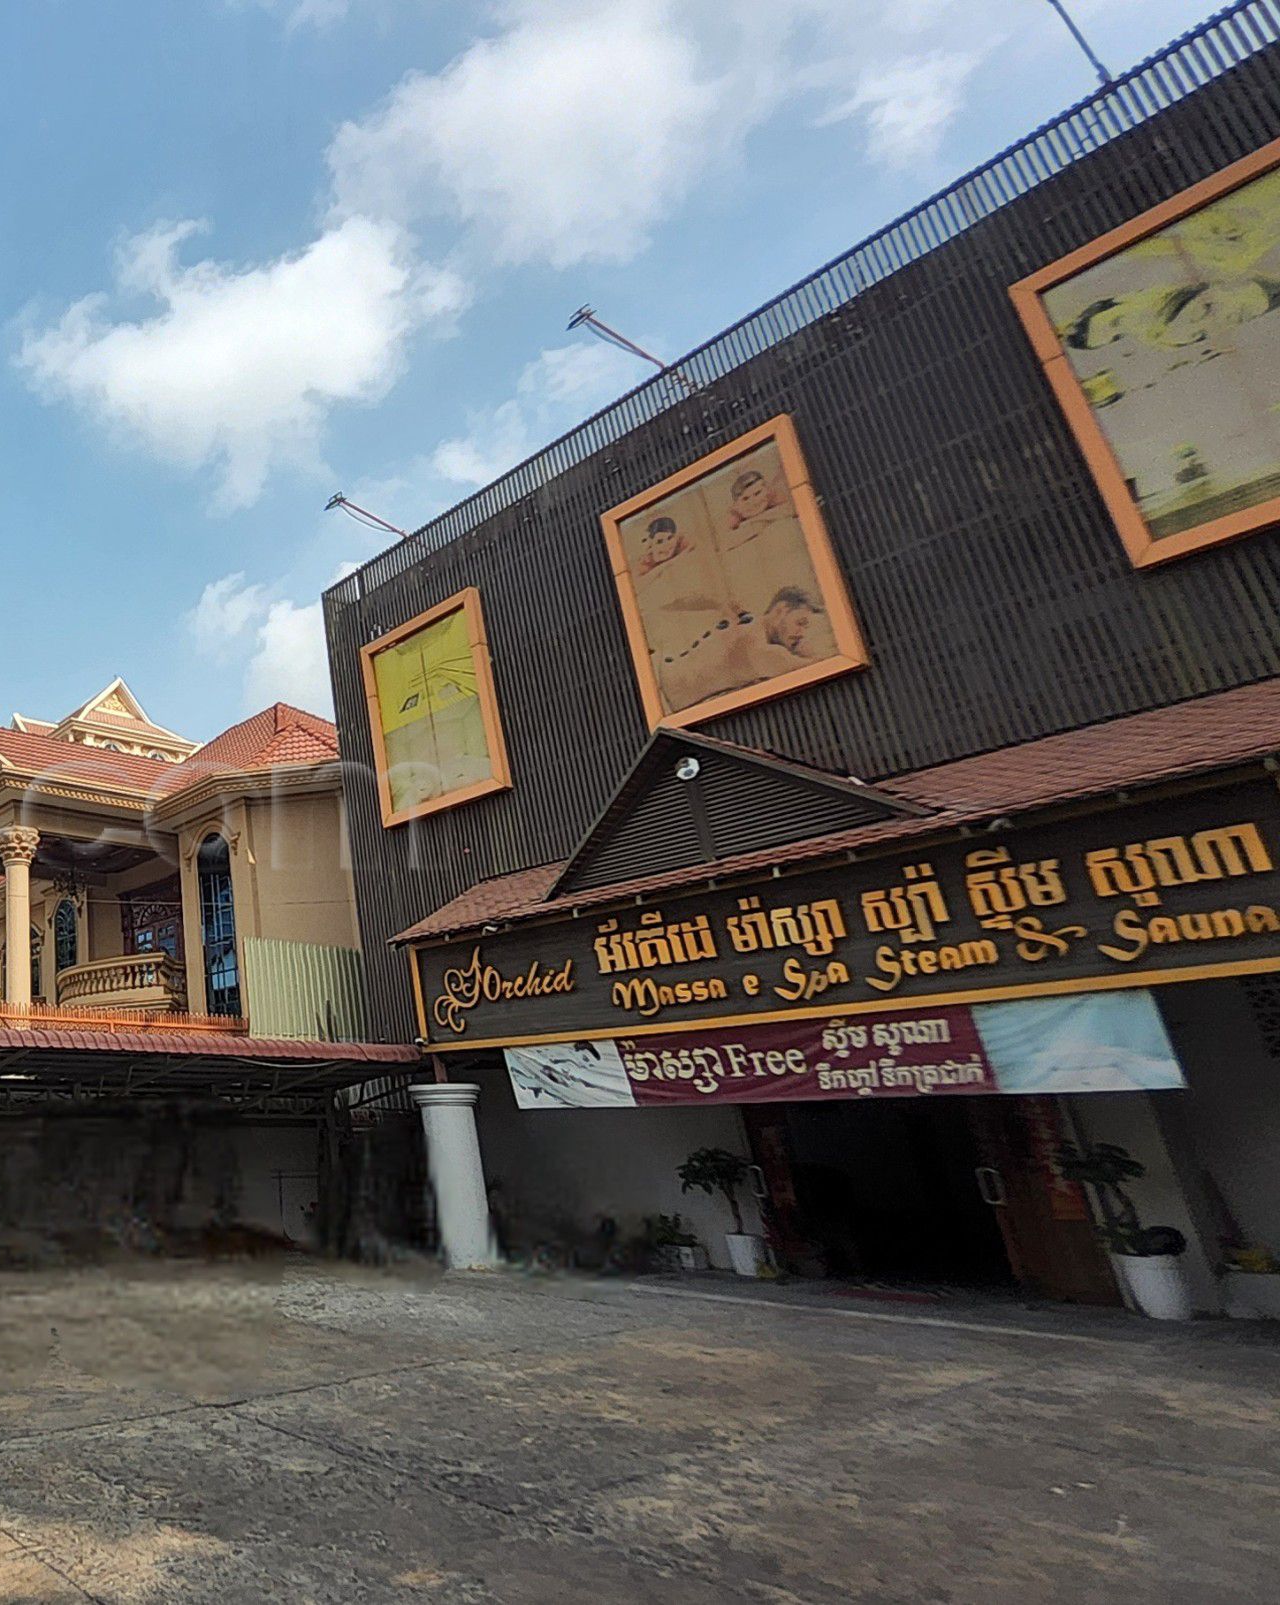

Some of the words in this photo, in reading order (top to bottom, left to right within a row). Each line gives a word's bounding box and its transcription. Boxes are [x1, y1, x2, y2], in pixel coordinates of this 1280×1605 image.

[483, 958, 576, 1001] Orchid
[612, 976, 728, 1017] Massa
[773, 957, 851, 1001] Spa
[865, 938, 1000, 991] Steam
[1014, 915, 1088, 962] &
[1097, 904, 1280, 962] Sauna
[720, 1043, 808, 1078] Free
